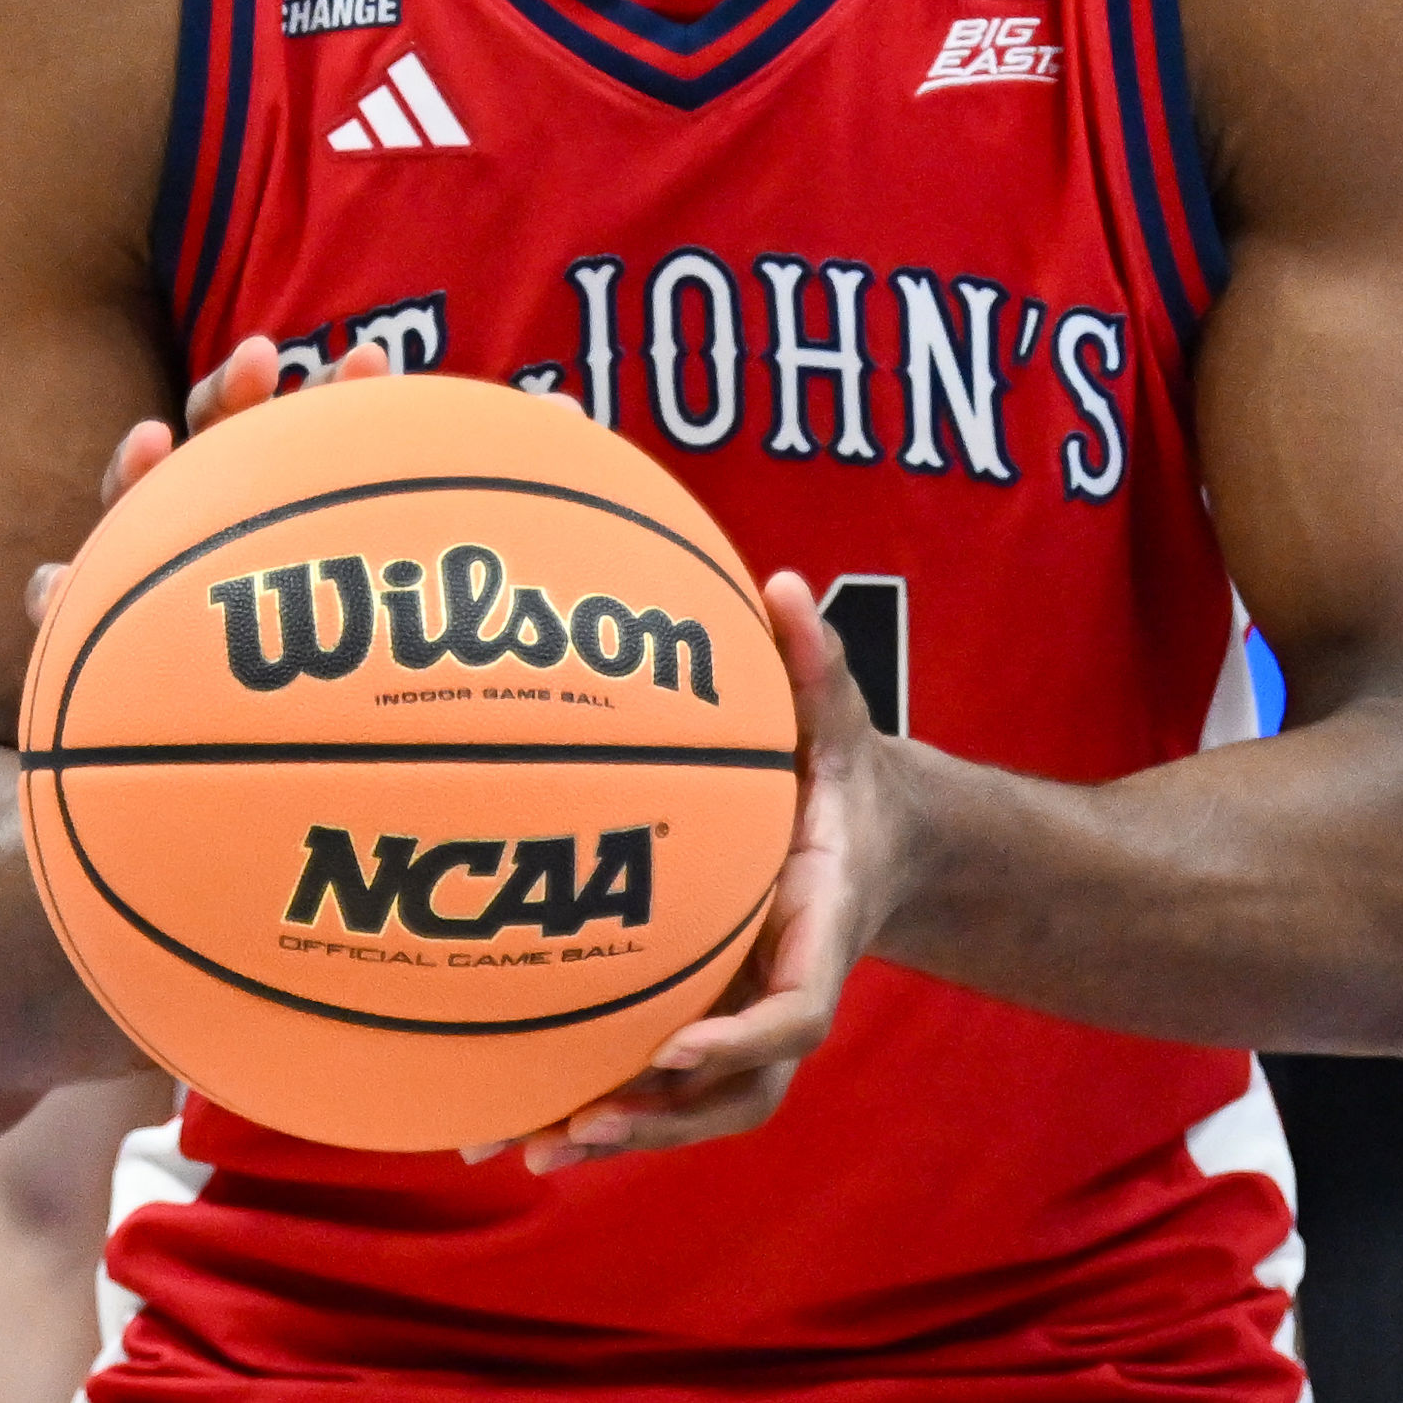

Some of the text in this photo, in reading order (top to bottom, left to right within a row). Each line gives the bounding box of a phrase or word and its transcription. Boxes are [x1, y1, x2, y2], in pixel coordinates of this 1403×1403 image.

[944, 17, 1041, 49] BIG
[927, 45, 1065, 78] EAST
[208, 542, 720, 707] Wilson
[374, 687, 616, 709] INDOOR GAME BALL
[281, 822, 655, 942] NCAA
[278, 934, 644, 968] OFFICIAL GAME BALL
